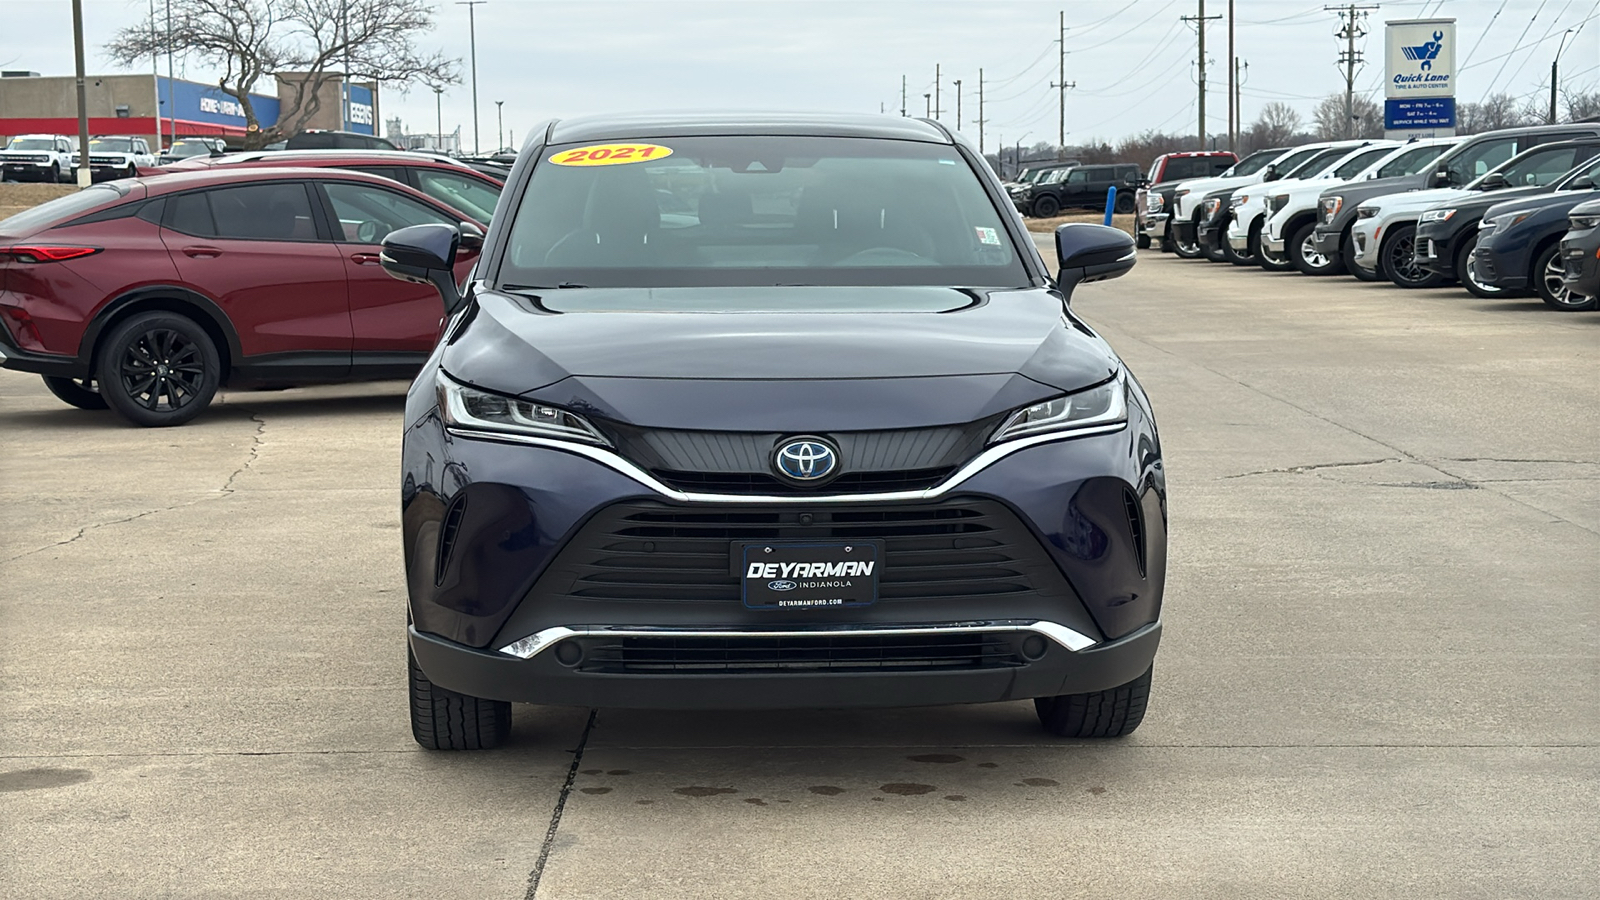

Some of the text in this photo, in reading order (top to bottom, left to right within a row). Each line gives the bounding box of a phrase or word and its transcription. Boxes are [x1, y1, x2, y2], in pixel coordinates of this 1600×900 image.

[1393, 73, 1449, 83] Quick Lane
[562, 147, 656, 163] 2021
[746, 561, 874, 578] DEYARMAN
[799, 580, 852, 588] INDIANOLA
[778, 599, 842, 607] DEYARMANFORD.COM
